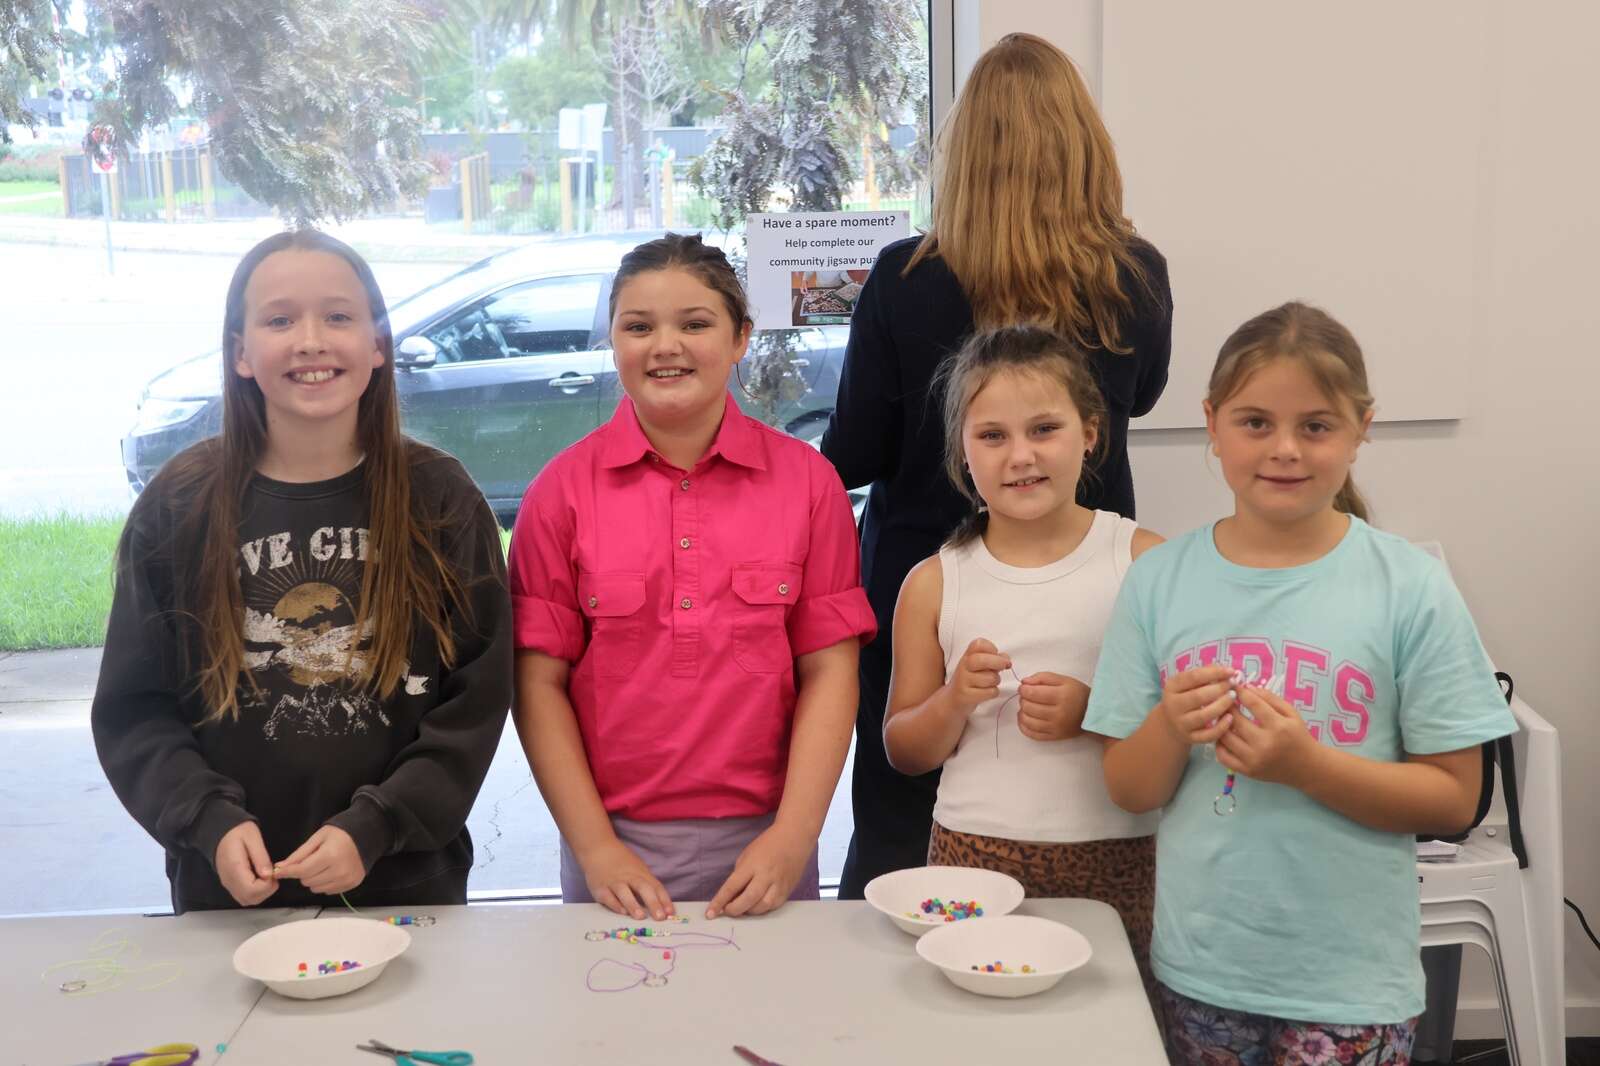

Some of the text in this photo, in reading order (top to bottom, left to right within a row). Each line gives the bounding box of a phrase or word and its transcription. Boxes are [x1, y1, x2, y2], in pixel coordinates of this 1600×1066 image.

[763, 216, 896, 230] Have a spare moment?
[785, 239, 808, 249] Help
[810, 238, 855, 248] complete
[769, 256, 825, 267] community
[826, 256, 857, 267] jigsaw
[237, 531, 293, 577] VE
